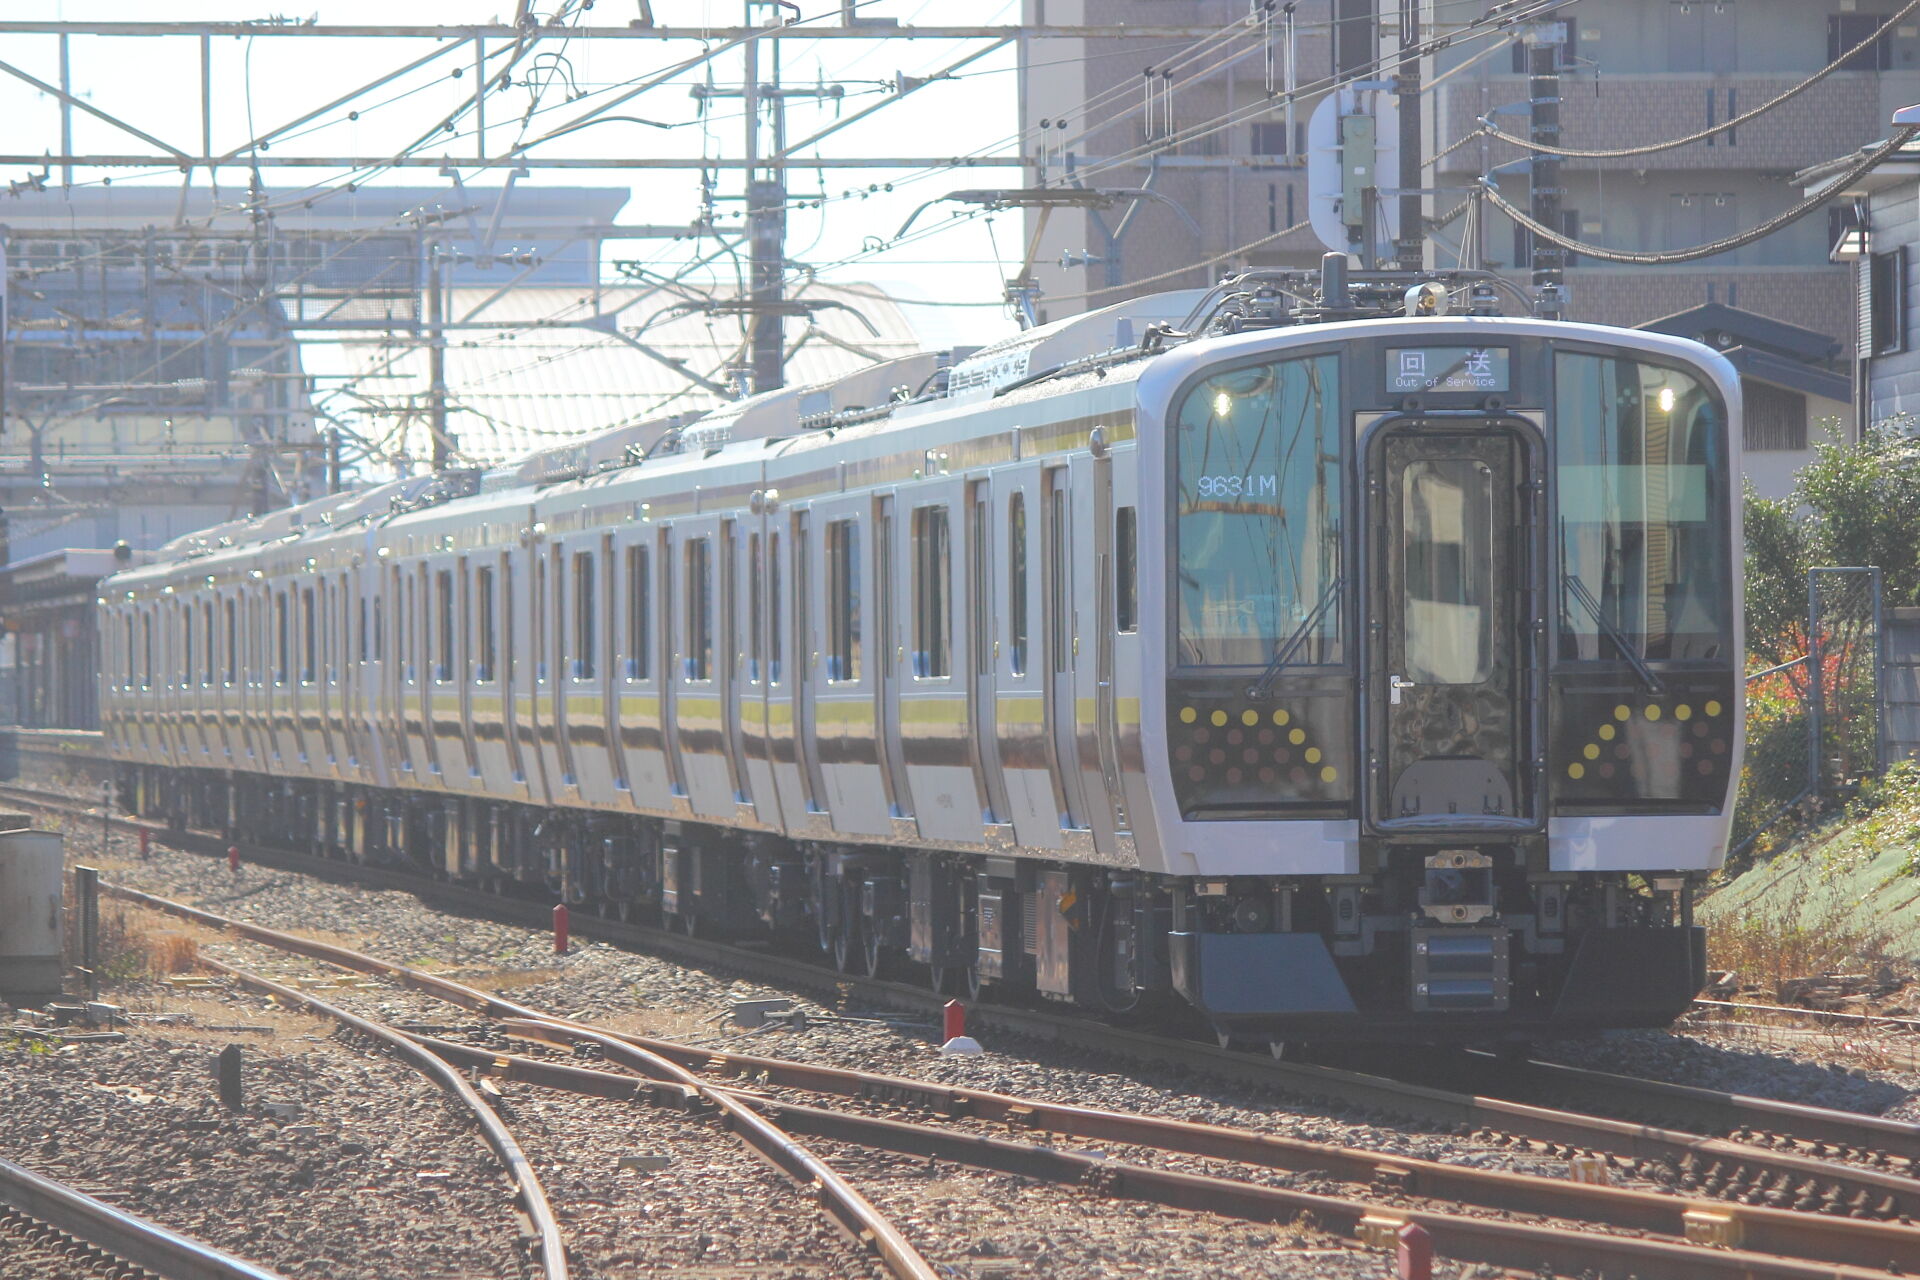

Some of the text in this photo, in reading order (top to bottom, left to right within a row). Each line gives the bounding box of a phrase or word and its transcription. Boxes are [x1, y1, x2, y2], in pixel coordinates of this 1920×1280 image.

[1400, 349, 1492, 377] 回送
[1395, 376, 1496, 387] Out of Service
[1198, 475, 1276, 496] 9631M
